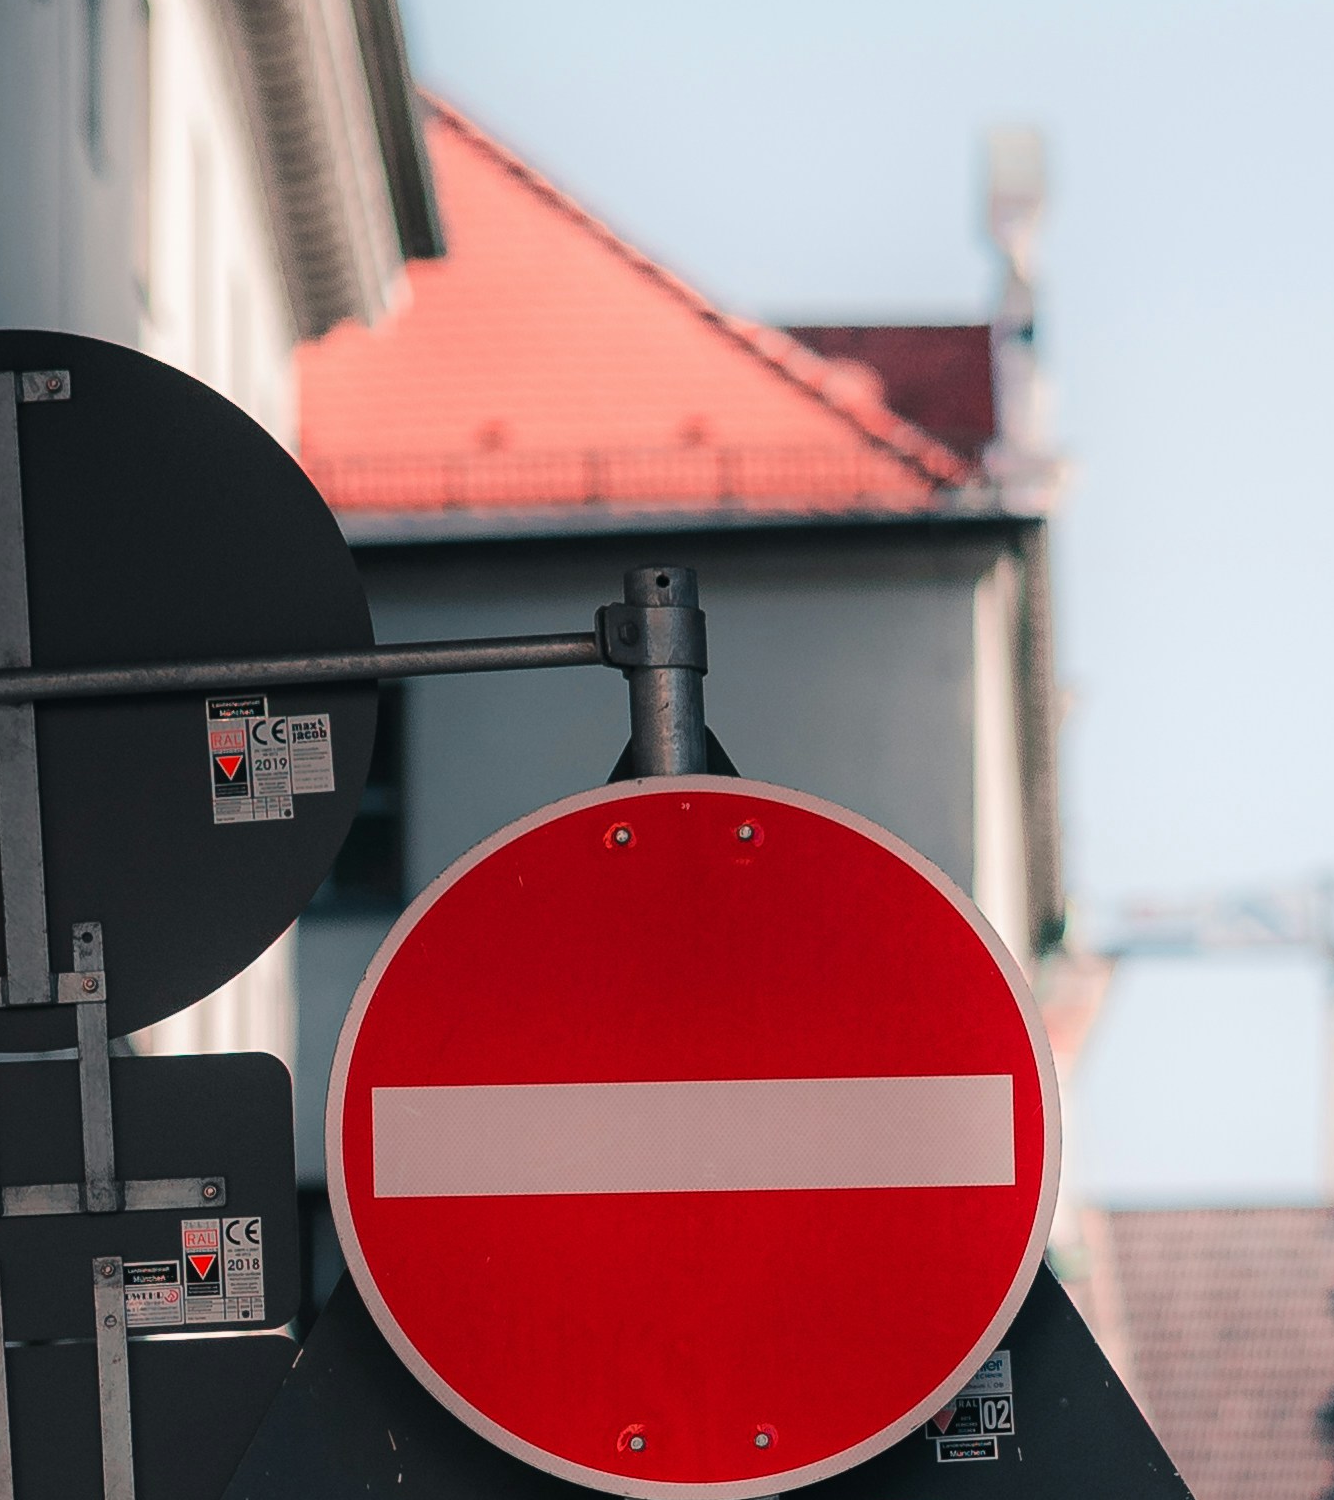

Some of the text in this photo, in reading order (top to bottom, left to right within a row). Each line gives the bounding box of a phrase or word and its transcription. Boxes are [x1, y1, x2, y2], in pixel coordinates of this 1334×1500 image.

[291, 722, 318, 732] max
[213, 733, 243, 747] RAL
[292, 729, 328, 745] jacob
[254, 758, 288, 772] 2019
[186, 1232, 216, 1247] RAL
[227, 1258, 261, 1272] 2018
[958, 1399, 978, 1408] RAL
[983, 1399, 1011, 1430] 02
